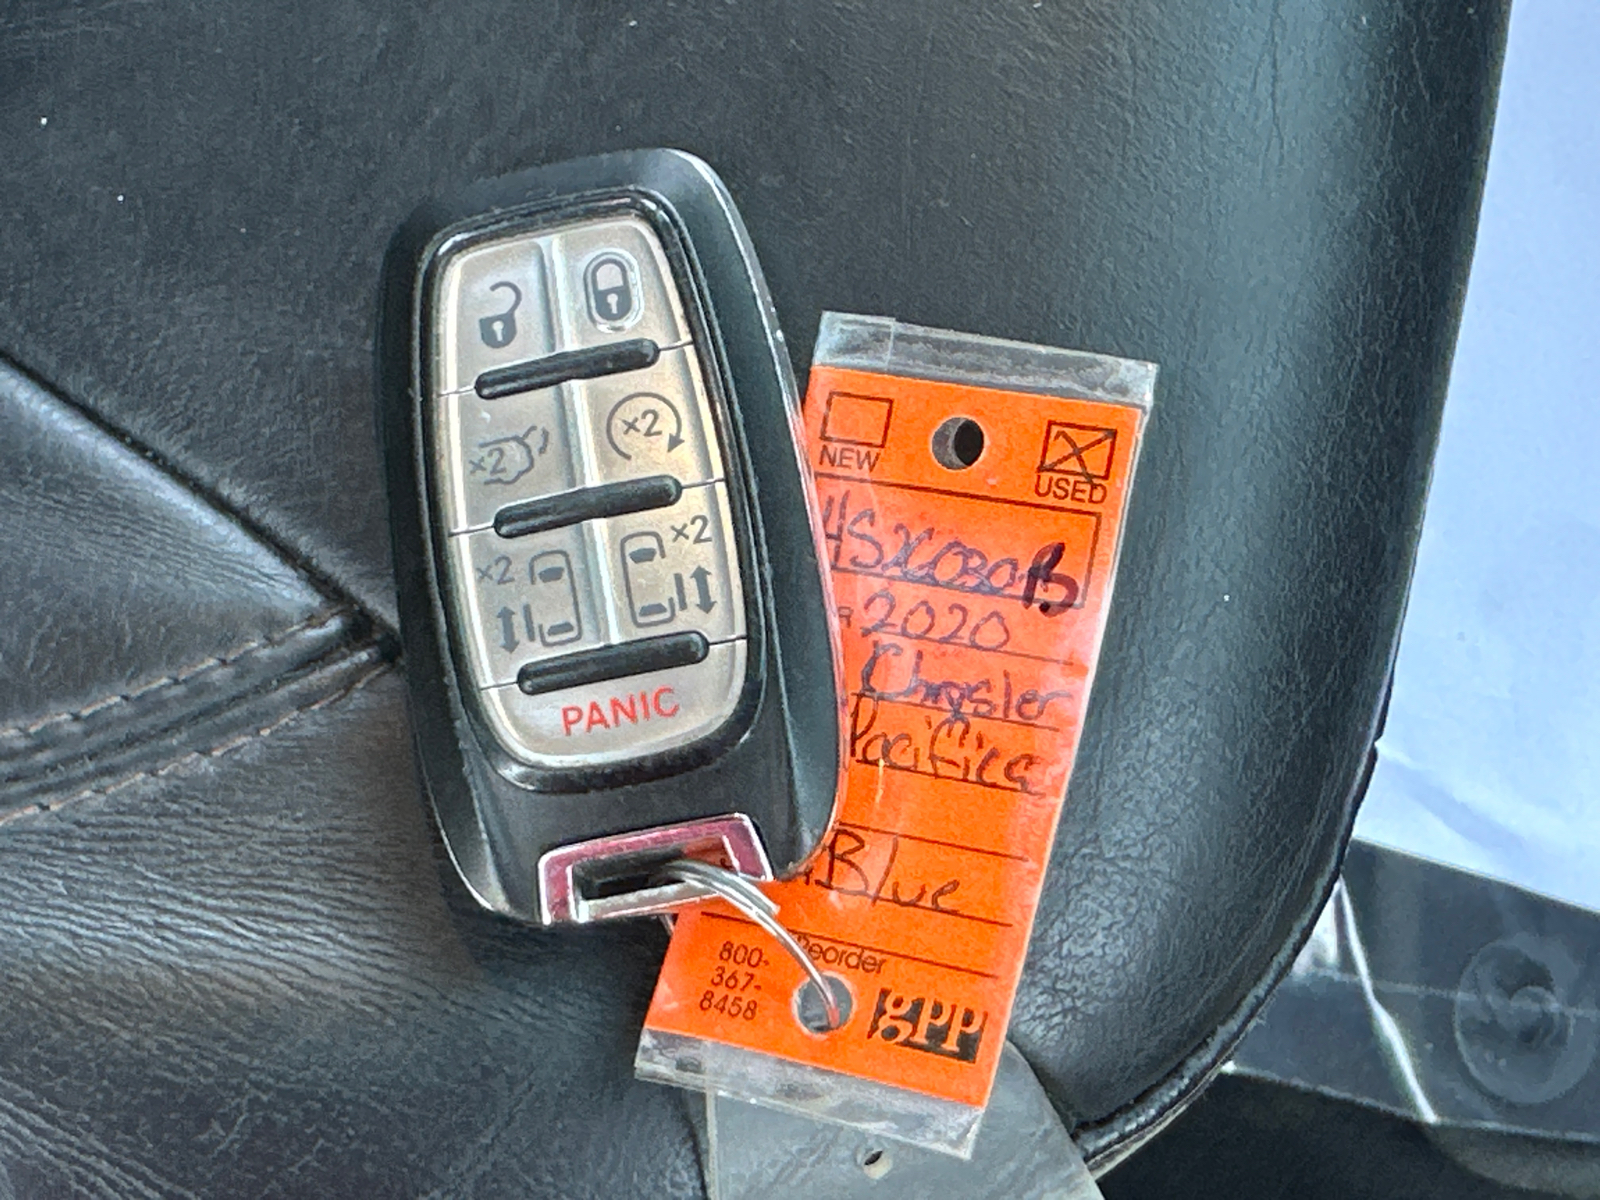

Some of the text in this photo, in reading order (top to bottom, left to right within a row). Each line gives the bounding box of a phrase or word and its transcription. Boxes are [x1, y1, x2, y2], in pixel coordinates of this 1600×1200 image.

[818, 446, 881, 473] NEW
[1034, 474, 1108, 505] USED
[861, 588, 1010, 651] 2020
[561, 685, 680, 736] PANIC
[816, 828, 960, 914] Blue
[719, 941, 769, 968] 800-
[711, 965, 762, 991] 367-
[699, 990, 757, 1021] 8458
